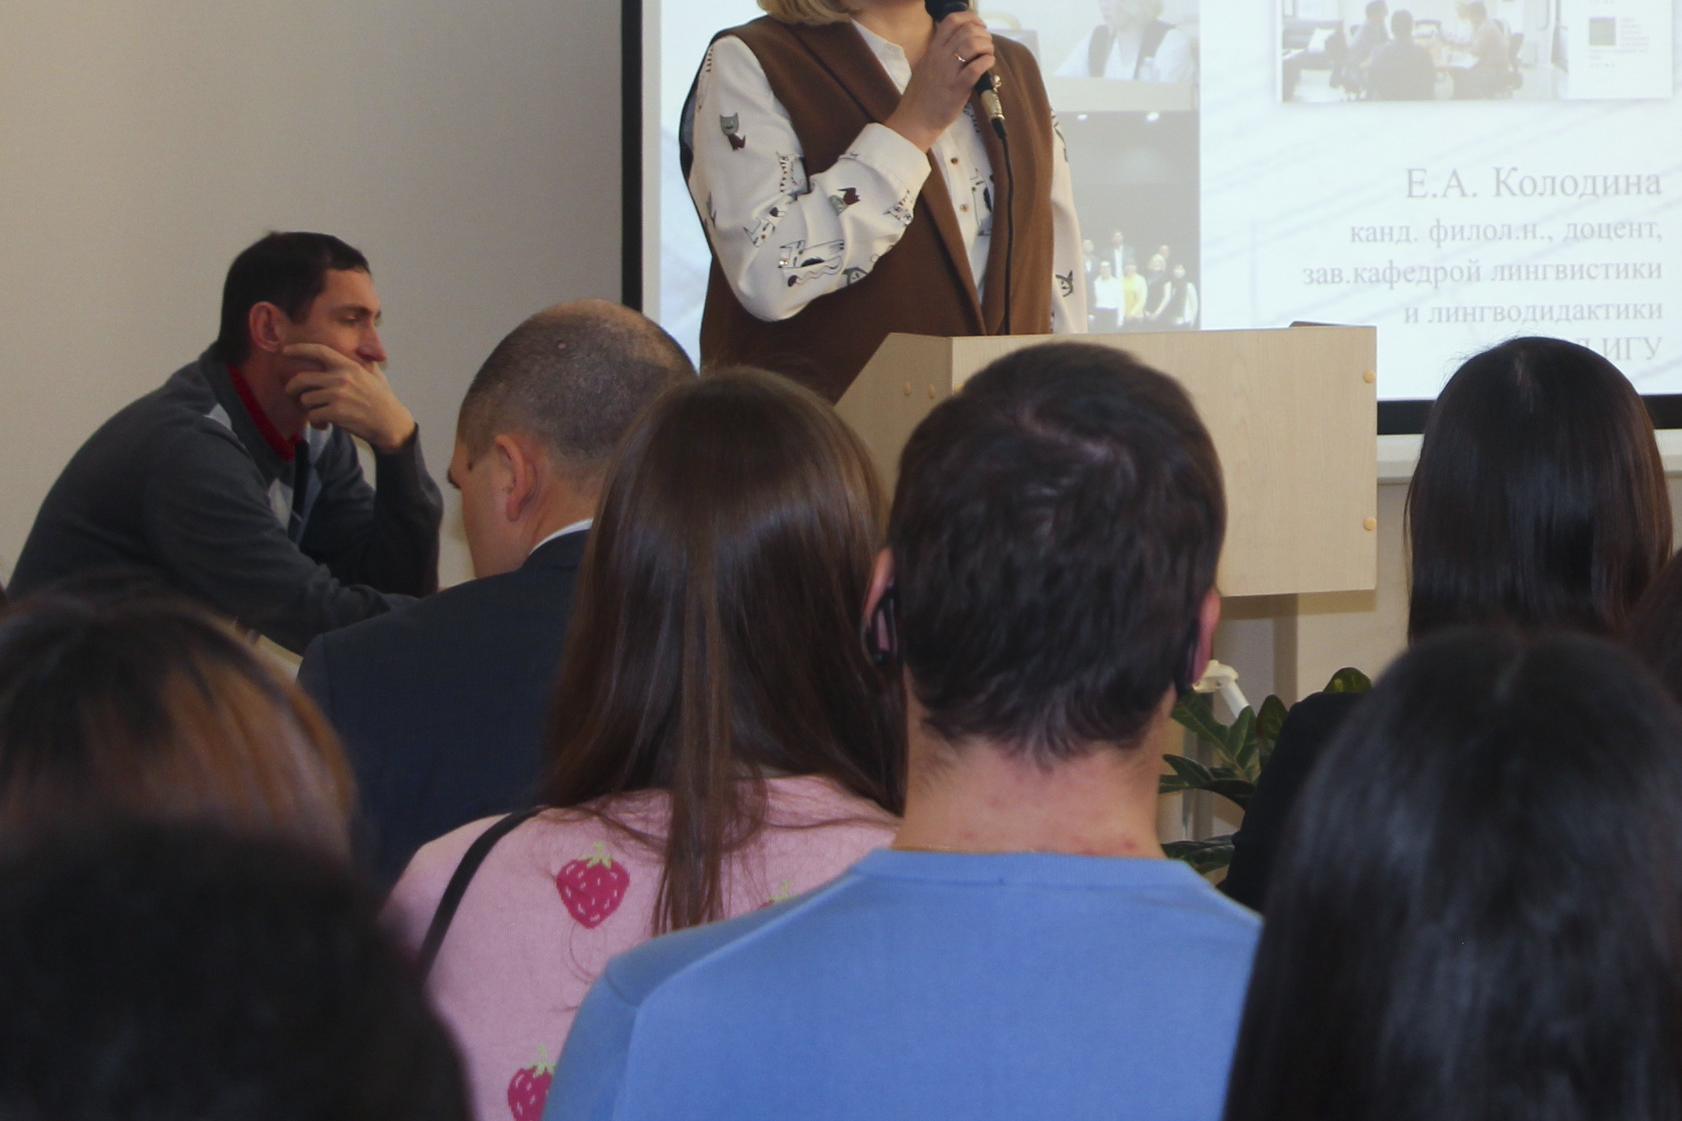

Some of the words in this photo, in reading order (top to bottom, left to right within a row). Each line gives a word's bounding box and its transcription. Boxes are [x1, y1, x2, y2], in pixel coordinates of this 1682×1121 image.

[1406, 167, 1478, 200] Е.А.
[1493, 166, 1663, 200] Колодина
[1349, 224, 1419, 246] канд.
[1563, 218, 1663, 246] доцент,
[1490, 261, 1663, 283] лингвистики
[1403, 303, 1420, 324] и
[1427, 302, 1664, 327] лингводидактики
